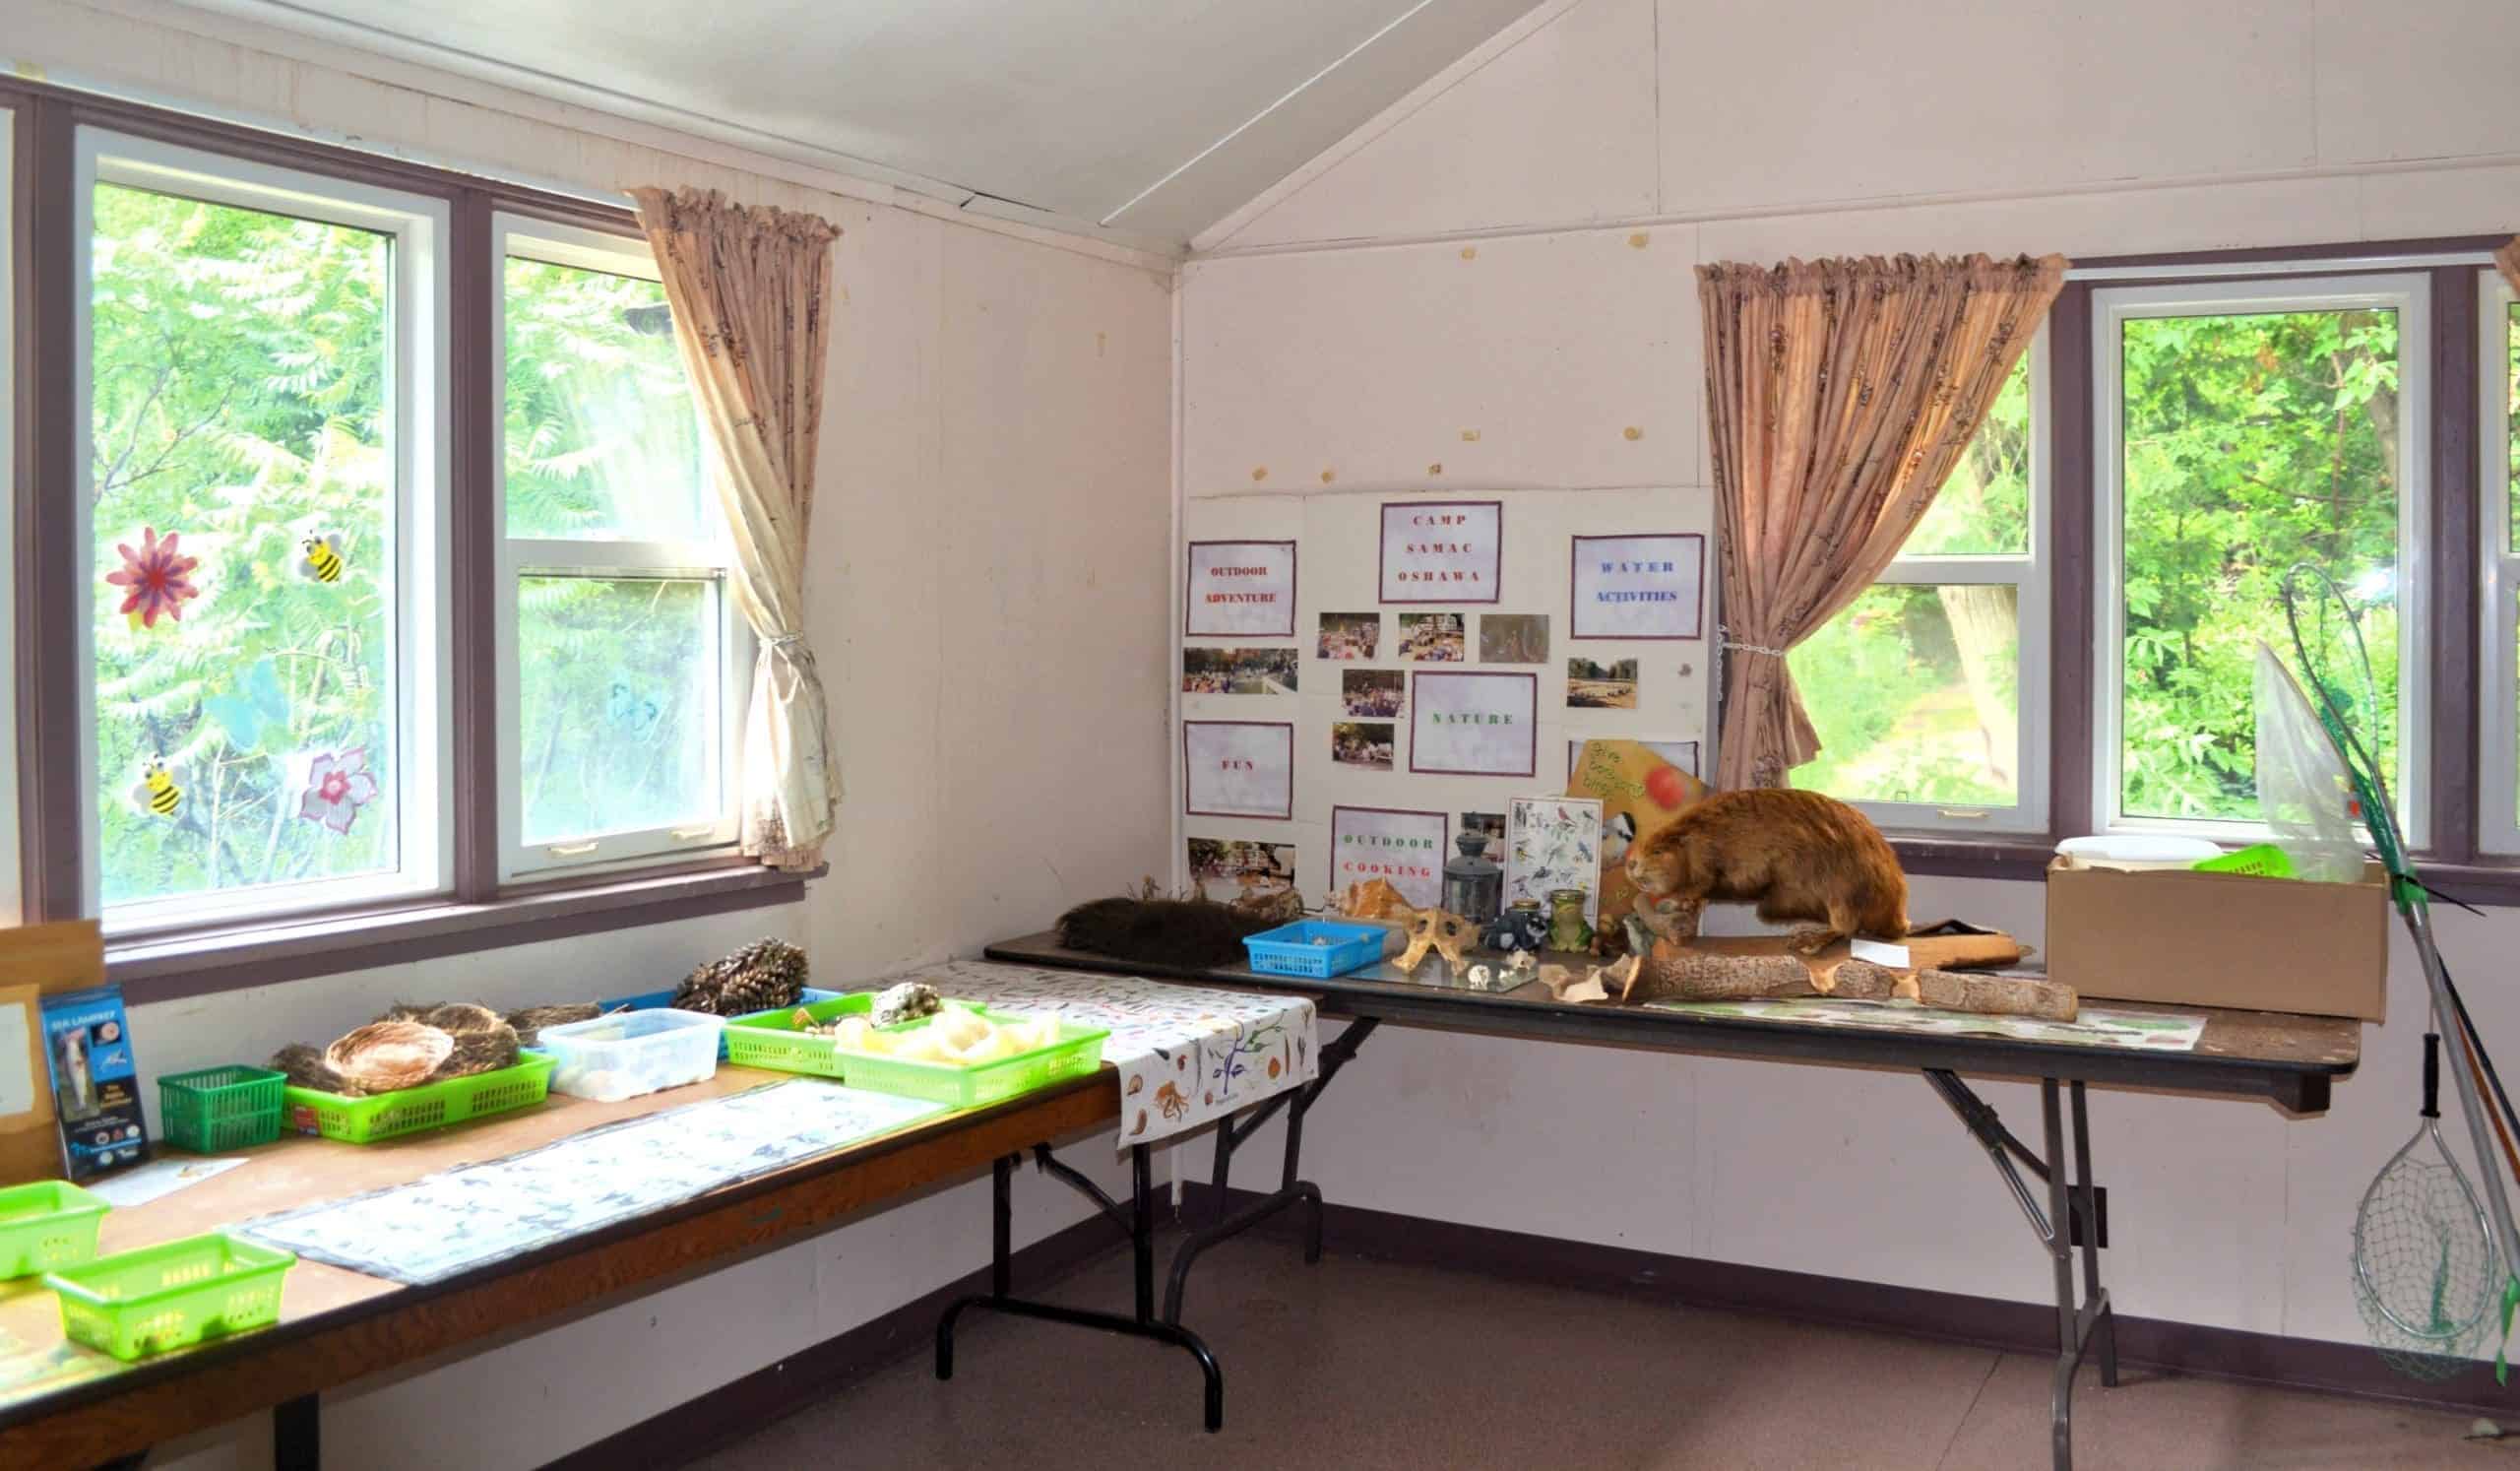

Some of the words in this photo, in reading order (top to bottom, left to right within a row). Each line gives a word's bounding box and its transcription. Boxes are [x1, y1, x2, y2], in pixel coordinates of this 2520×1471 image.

[1413, 514, 1467, 526] CAMP
[1406, 543, 1473, 553] SAMAC
[1211, 565, 1268, 577] OUTDOOR
[1600, 561, 1674, 573] WATER
[1398, 571, 1480, 582] OSHAWA
[1206, 593, 1277, 604] ADVENTURE
[1597, 591, 1677, 603] ACTIVITIES
[1432, 713, 1514, 725] NATURE
[1222, 759, 1254, 771] FUN
[1344, 833, 1434, 850] OUTDOOR
[1343, 861, 1431, 877] COOKING
